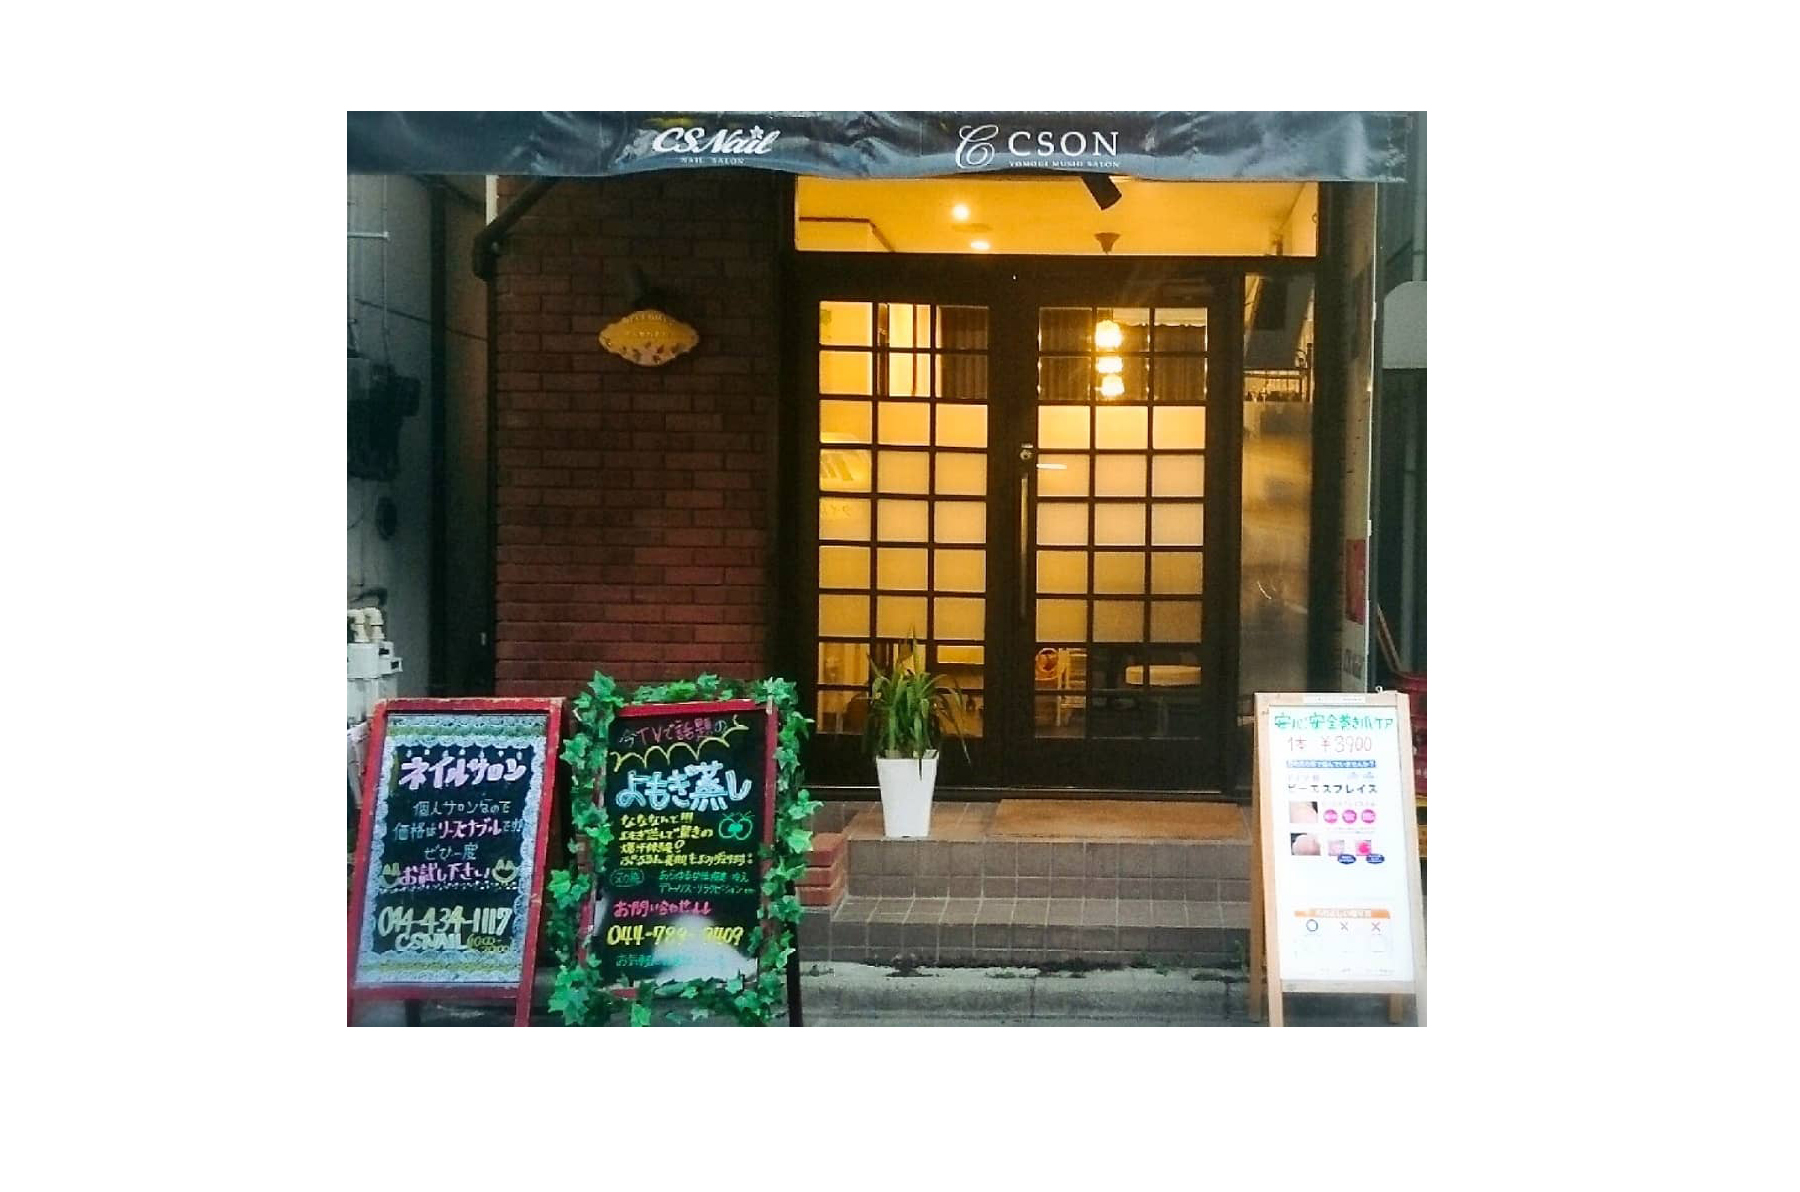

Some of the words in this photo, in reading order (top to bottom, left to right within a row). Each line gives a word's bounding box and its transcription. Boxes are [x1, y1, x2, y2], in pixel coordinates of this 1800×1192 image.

[1008, 131, 1119, 157] CSON
[399, 756, 527, 790] ネイルサロン
[615, 760, 753, 812] よもぎ蒸し
